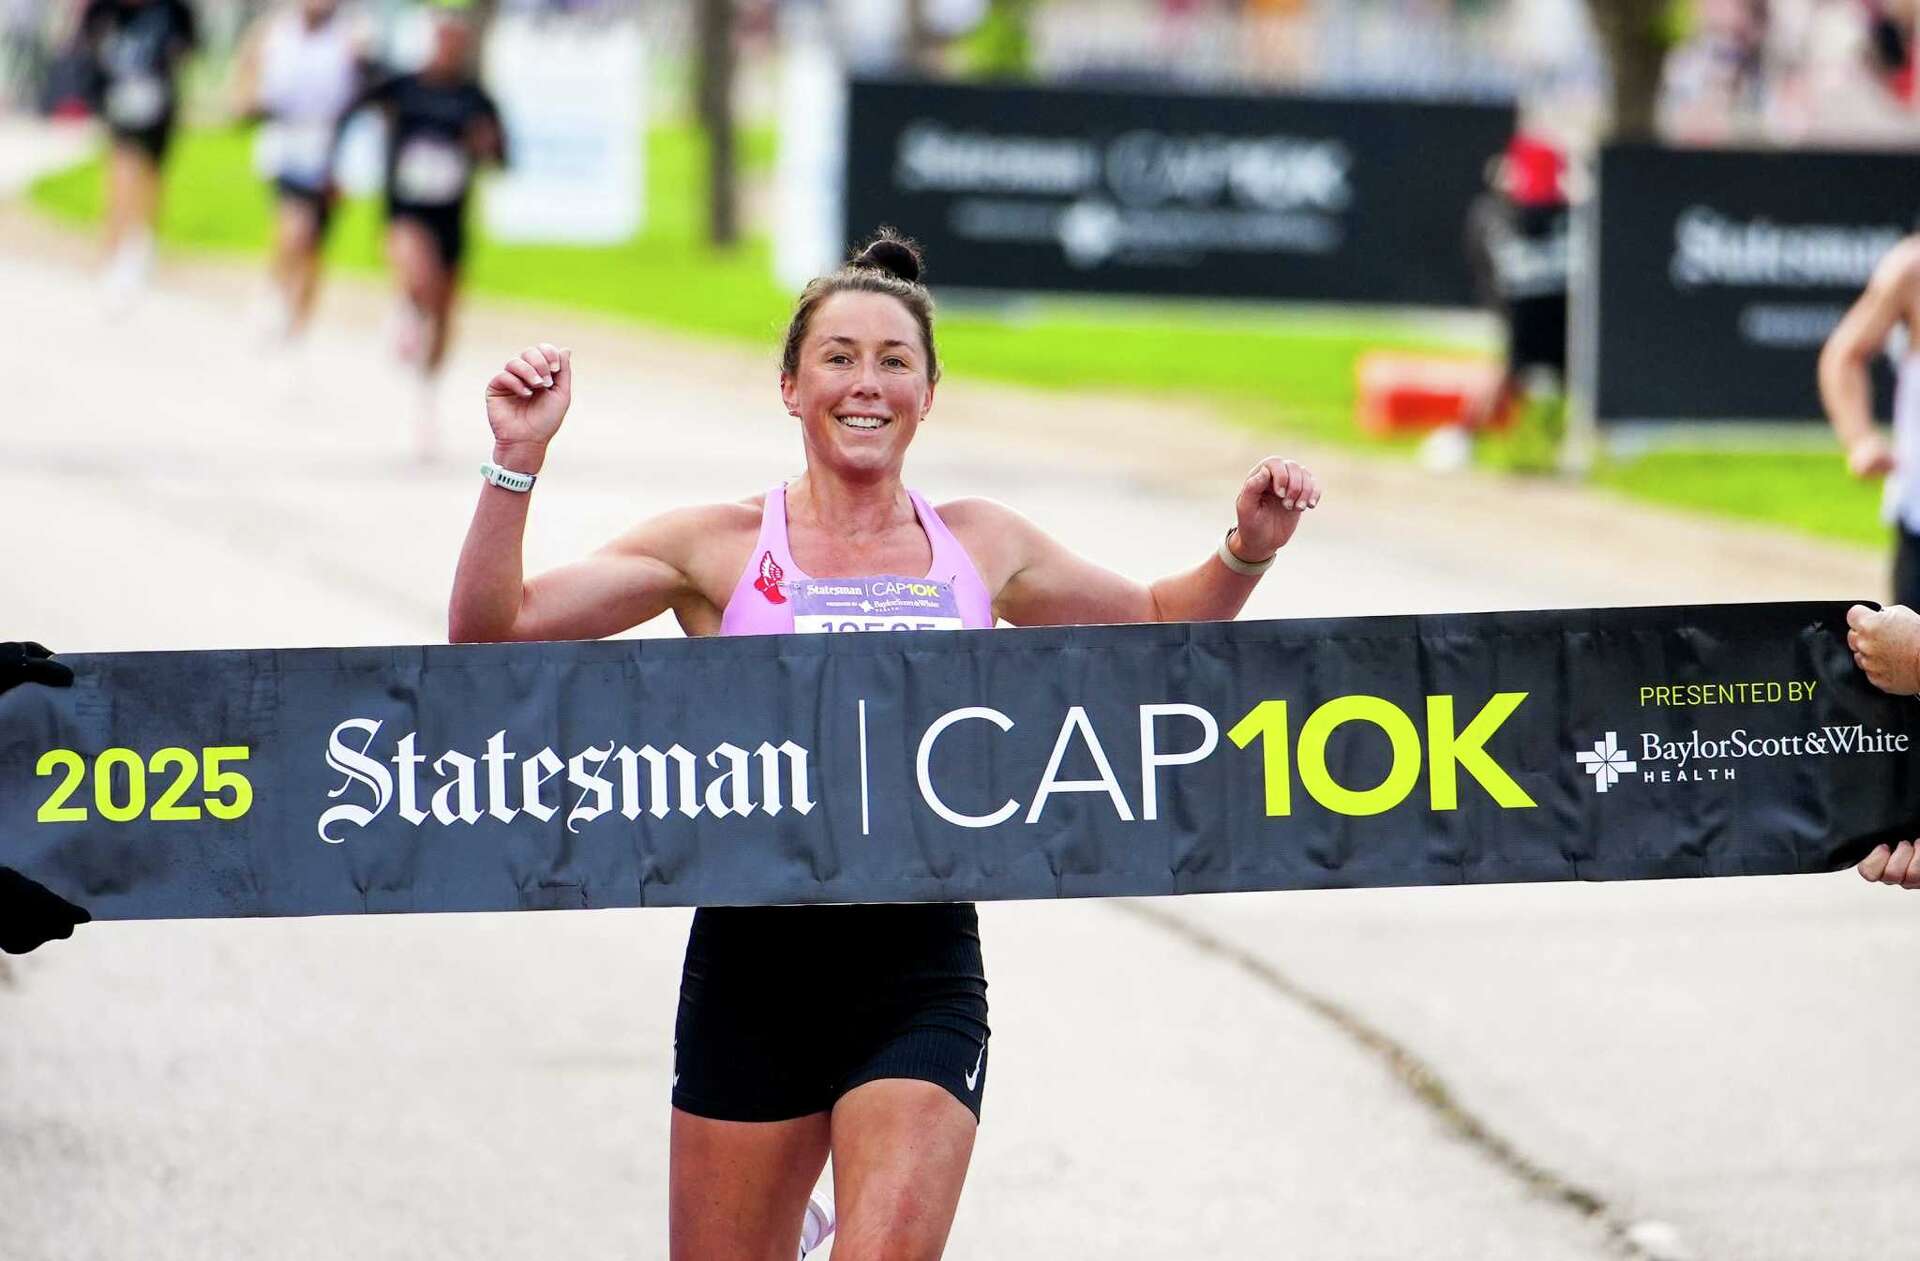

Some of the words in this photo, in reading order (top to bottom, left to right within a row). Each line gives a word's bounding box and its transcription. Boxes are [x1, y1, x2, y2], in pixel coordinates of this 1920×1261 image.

[806, 584, 862, 598] Statesman
[872, 582, 939, 597] CAP10K
[1640, 682, 1782, 706] PRESENTED
[1788, 680, 1817, 701] BY
[1640, 724, 1908, 768] BaylorScott&White
[36, 746, 253, 822] 2025
[318, 718, 817, 844] Statesman
[916, 692, 1538, 827] CAP10K
[1644, 768, 1736, 783] HEALTH
